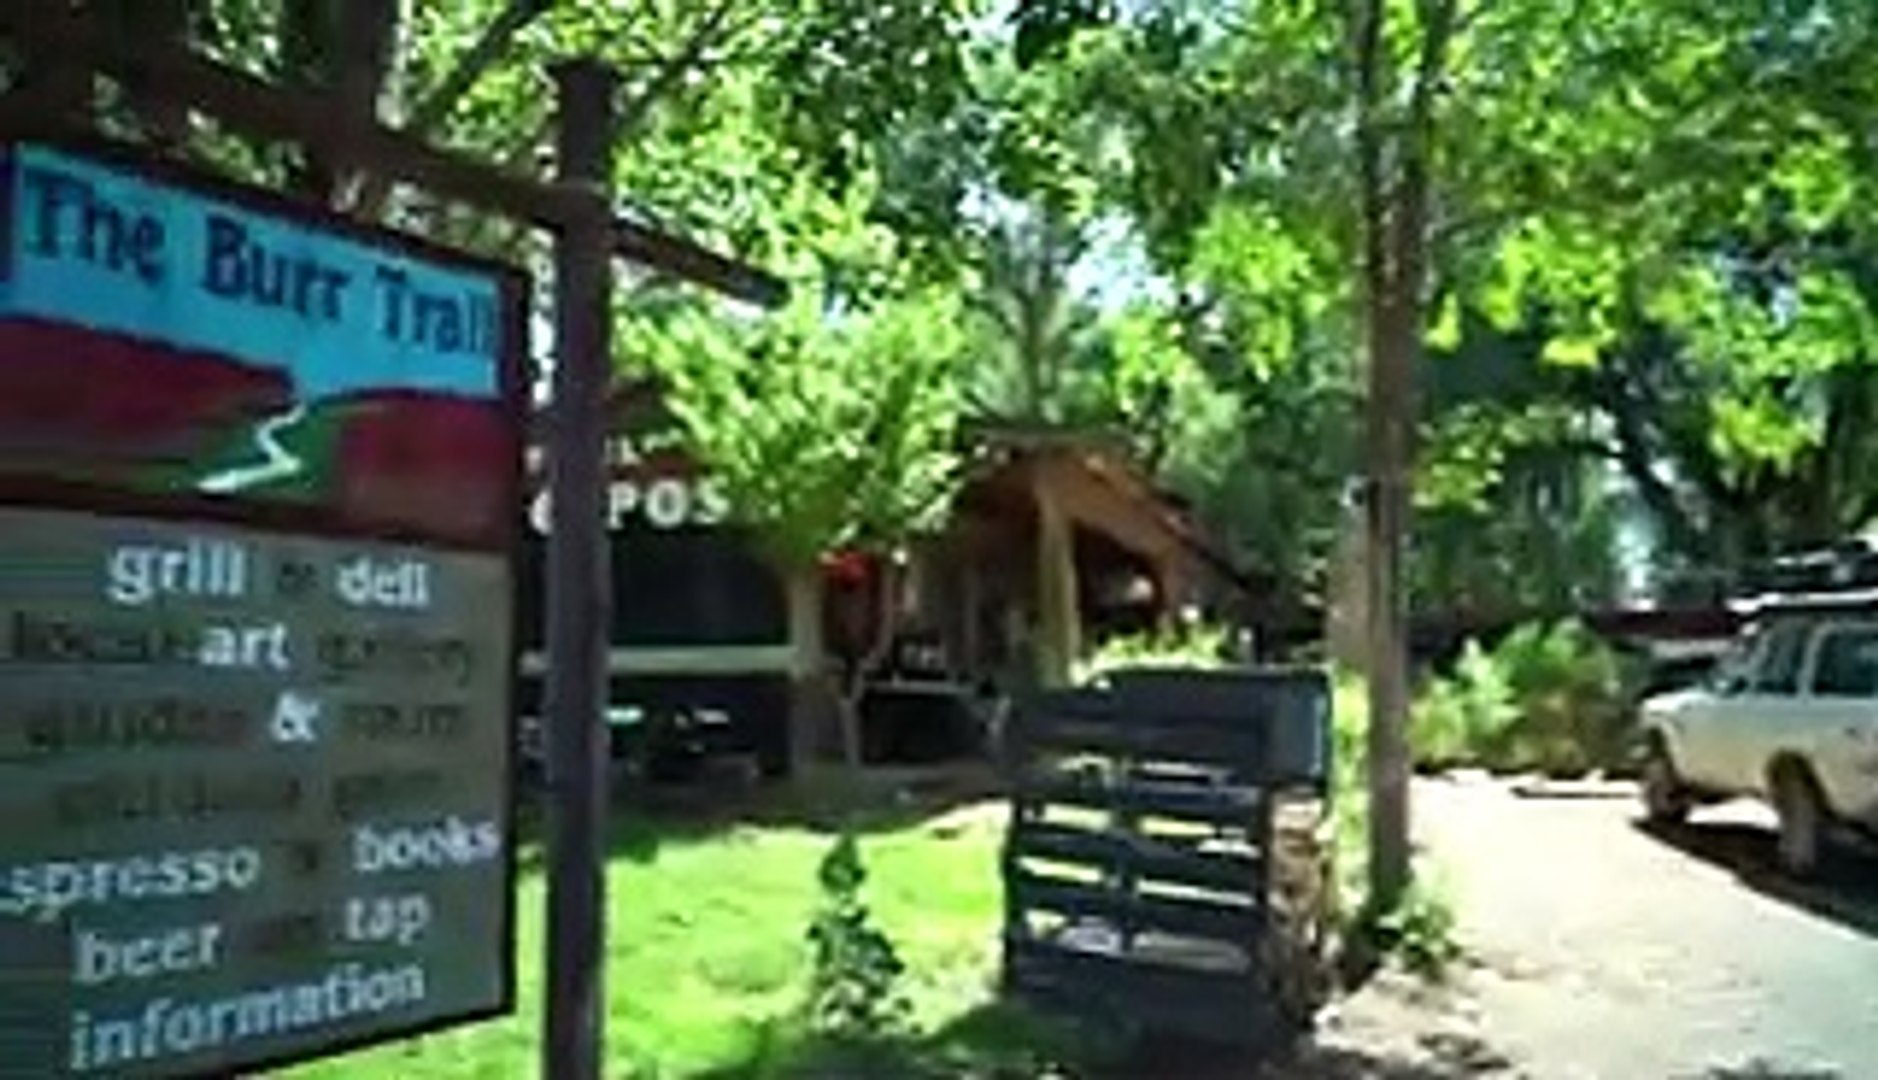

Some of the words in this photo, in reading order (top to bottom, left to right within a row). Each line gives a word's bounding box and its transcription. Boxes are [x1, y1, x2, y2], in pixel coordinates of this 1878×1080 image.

[22, 168, 166, 282] The
[204, 215, 350, 321] Burr
[374, 264, 498, 356] Trail
[107, 542, 246, 605] grill
[335, 555, 431, 606] deli
[201, 623, 290, 670] art
[270, 692, 320, 743] &
[0, 845, 260, 924] spresso
[352, 815, 499, 872] books
[74, 922, 222, 983] beer
[345, 895, 428, 945] tap
[68, 963, 425, 1070] information
